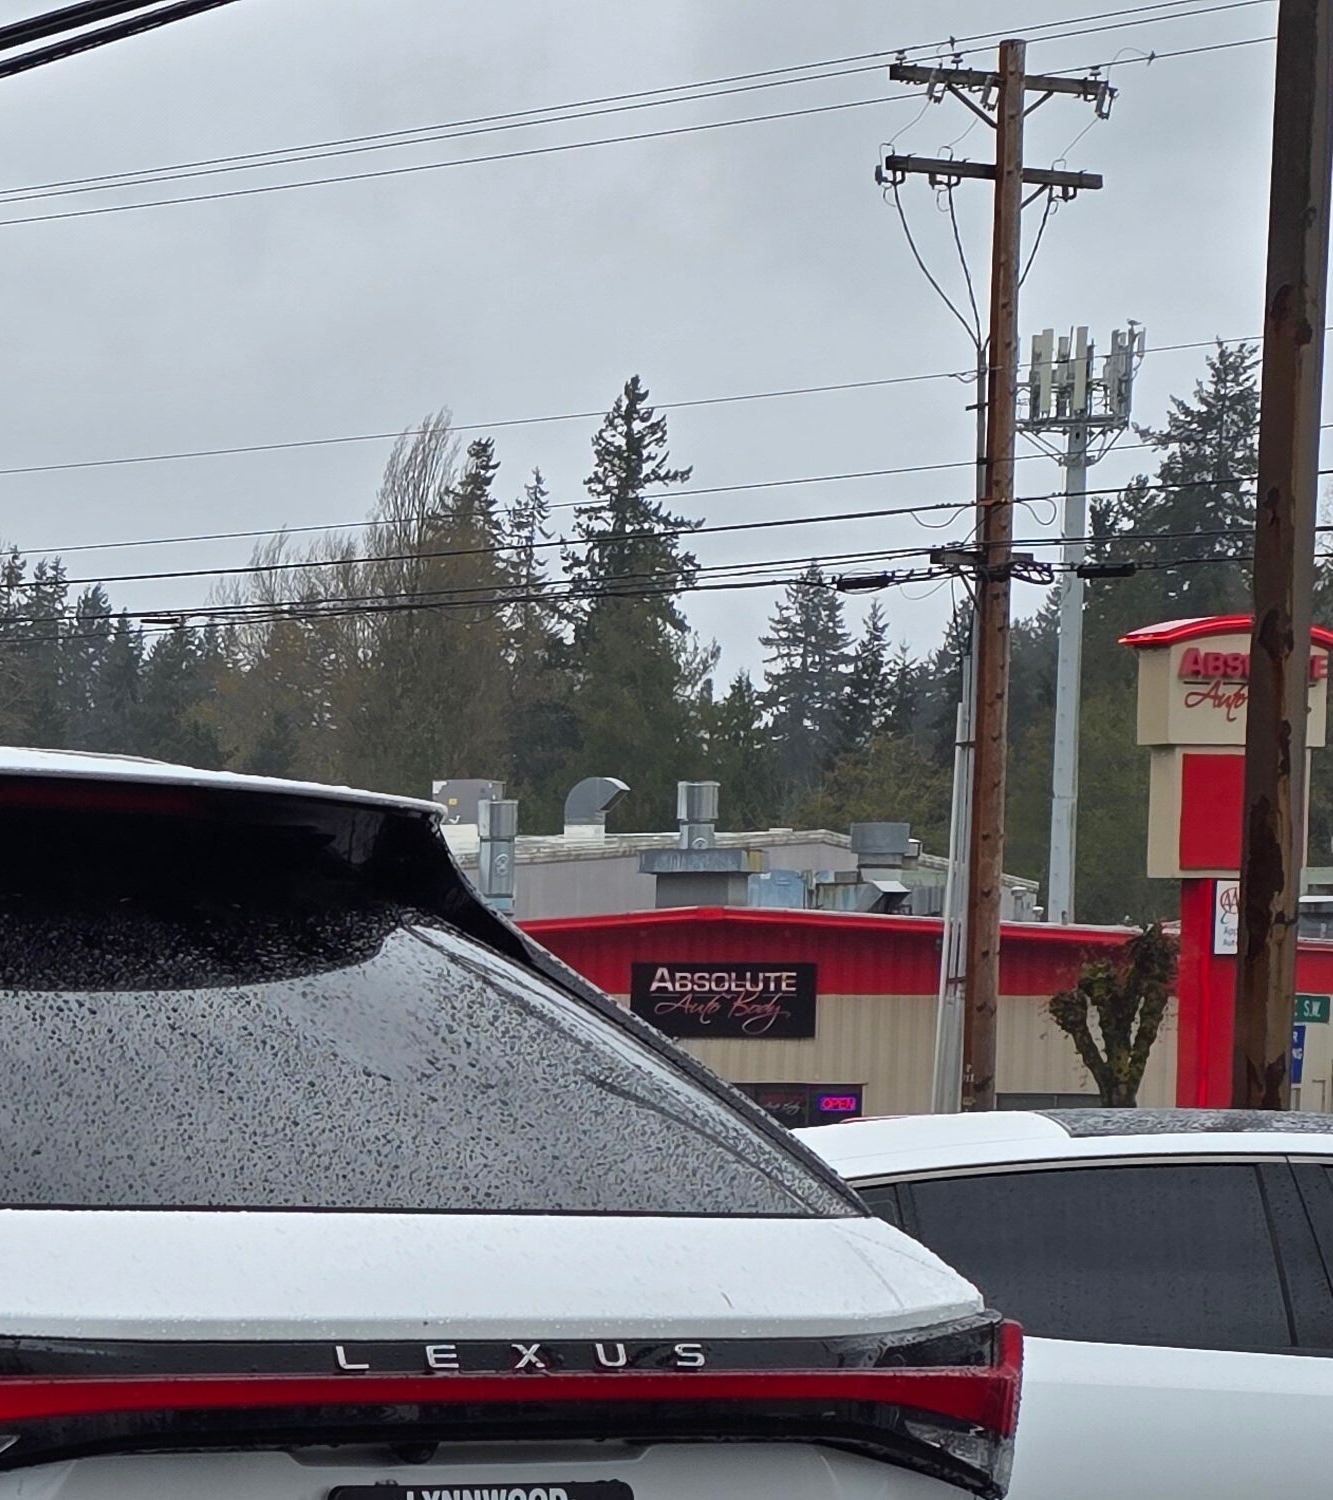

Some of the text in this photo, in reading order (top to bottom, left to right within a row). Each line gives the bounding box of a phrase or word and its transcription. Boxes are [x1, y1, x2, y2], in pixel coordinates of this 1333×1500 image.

[649, 967, 798, 992] ABSOLUTE
[654, 986, 790, 1035] Auto Body
[822, 1098, 855, 1110] OPEN
[335, 1343, 706, 1370] LEXUS
